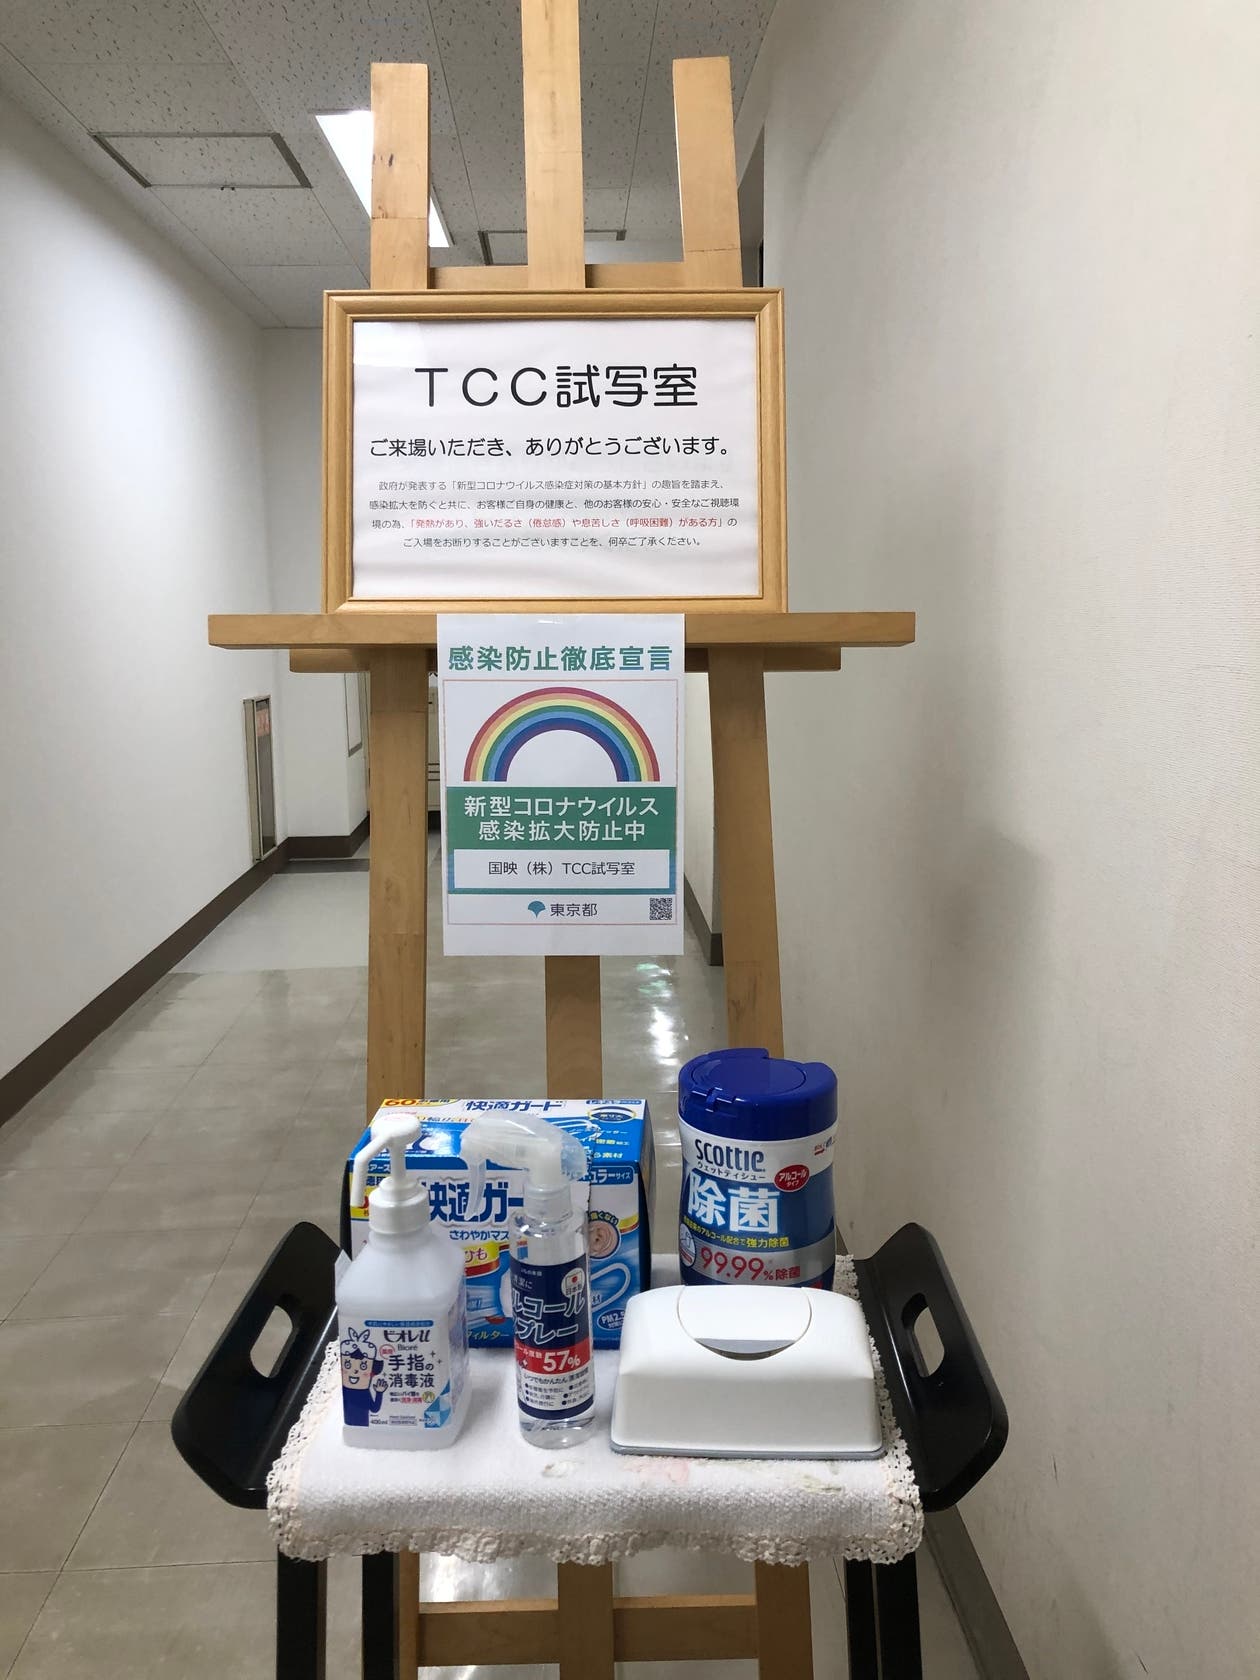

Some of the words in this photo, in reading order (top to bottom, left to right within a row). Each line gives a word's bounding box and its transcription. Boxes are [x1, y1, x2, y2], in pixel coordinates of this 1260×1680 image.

[414, 363, 698, 408] TCC試写室
[370, 437, 729, 458] ご来場いただき、ありがとうございます。
[403, 536, 702, 548] ご入場をお断りすることがございますことを、何卒ご了承ください。
[448, 645, 672, 671] 感染防止徹底宣言
[464, 795, 659, 817] 新型コロナウイルス
[478, 820, 646, 842] 感染拡大防止中
[488, 860, 635, 877] 国映（株）TCC試写室
[549, 902, 598, 918] 東京都
[778, 1168, 807, 1182] アルコール
[687, 1171, 780, 1234] 除菌
[700, 1246, 801, 1281] 99.99%除菌
[512, 1288, 586, 1320] ルコール
[513, 1316, 579, 1345] プレー
[388, 1353, 434, 1371] 手指の
[542, 1349, 581, 1373] 57%
[388, 1373, 435, 1388] 消毒液
